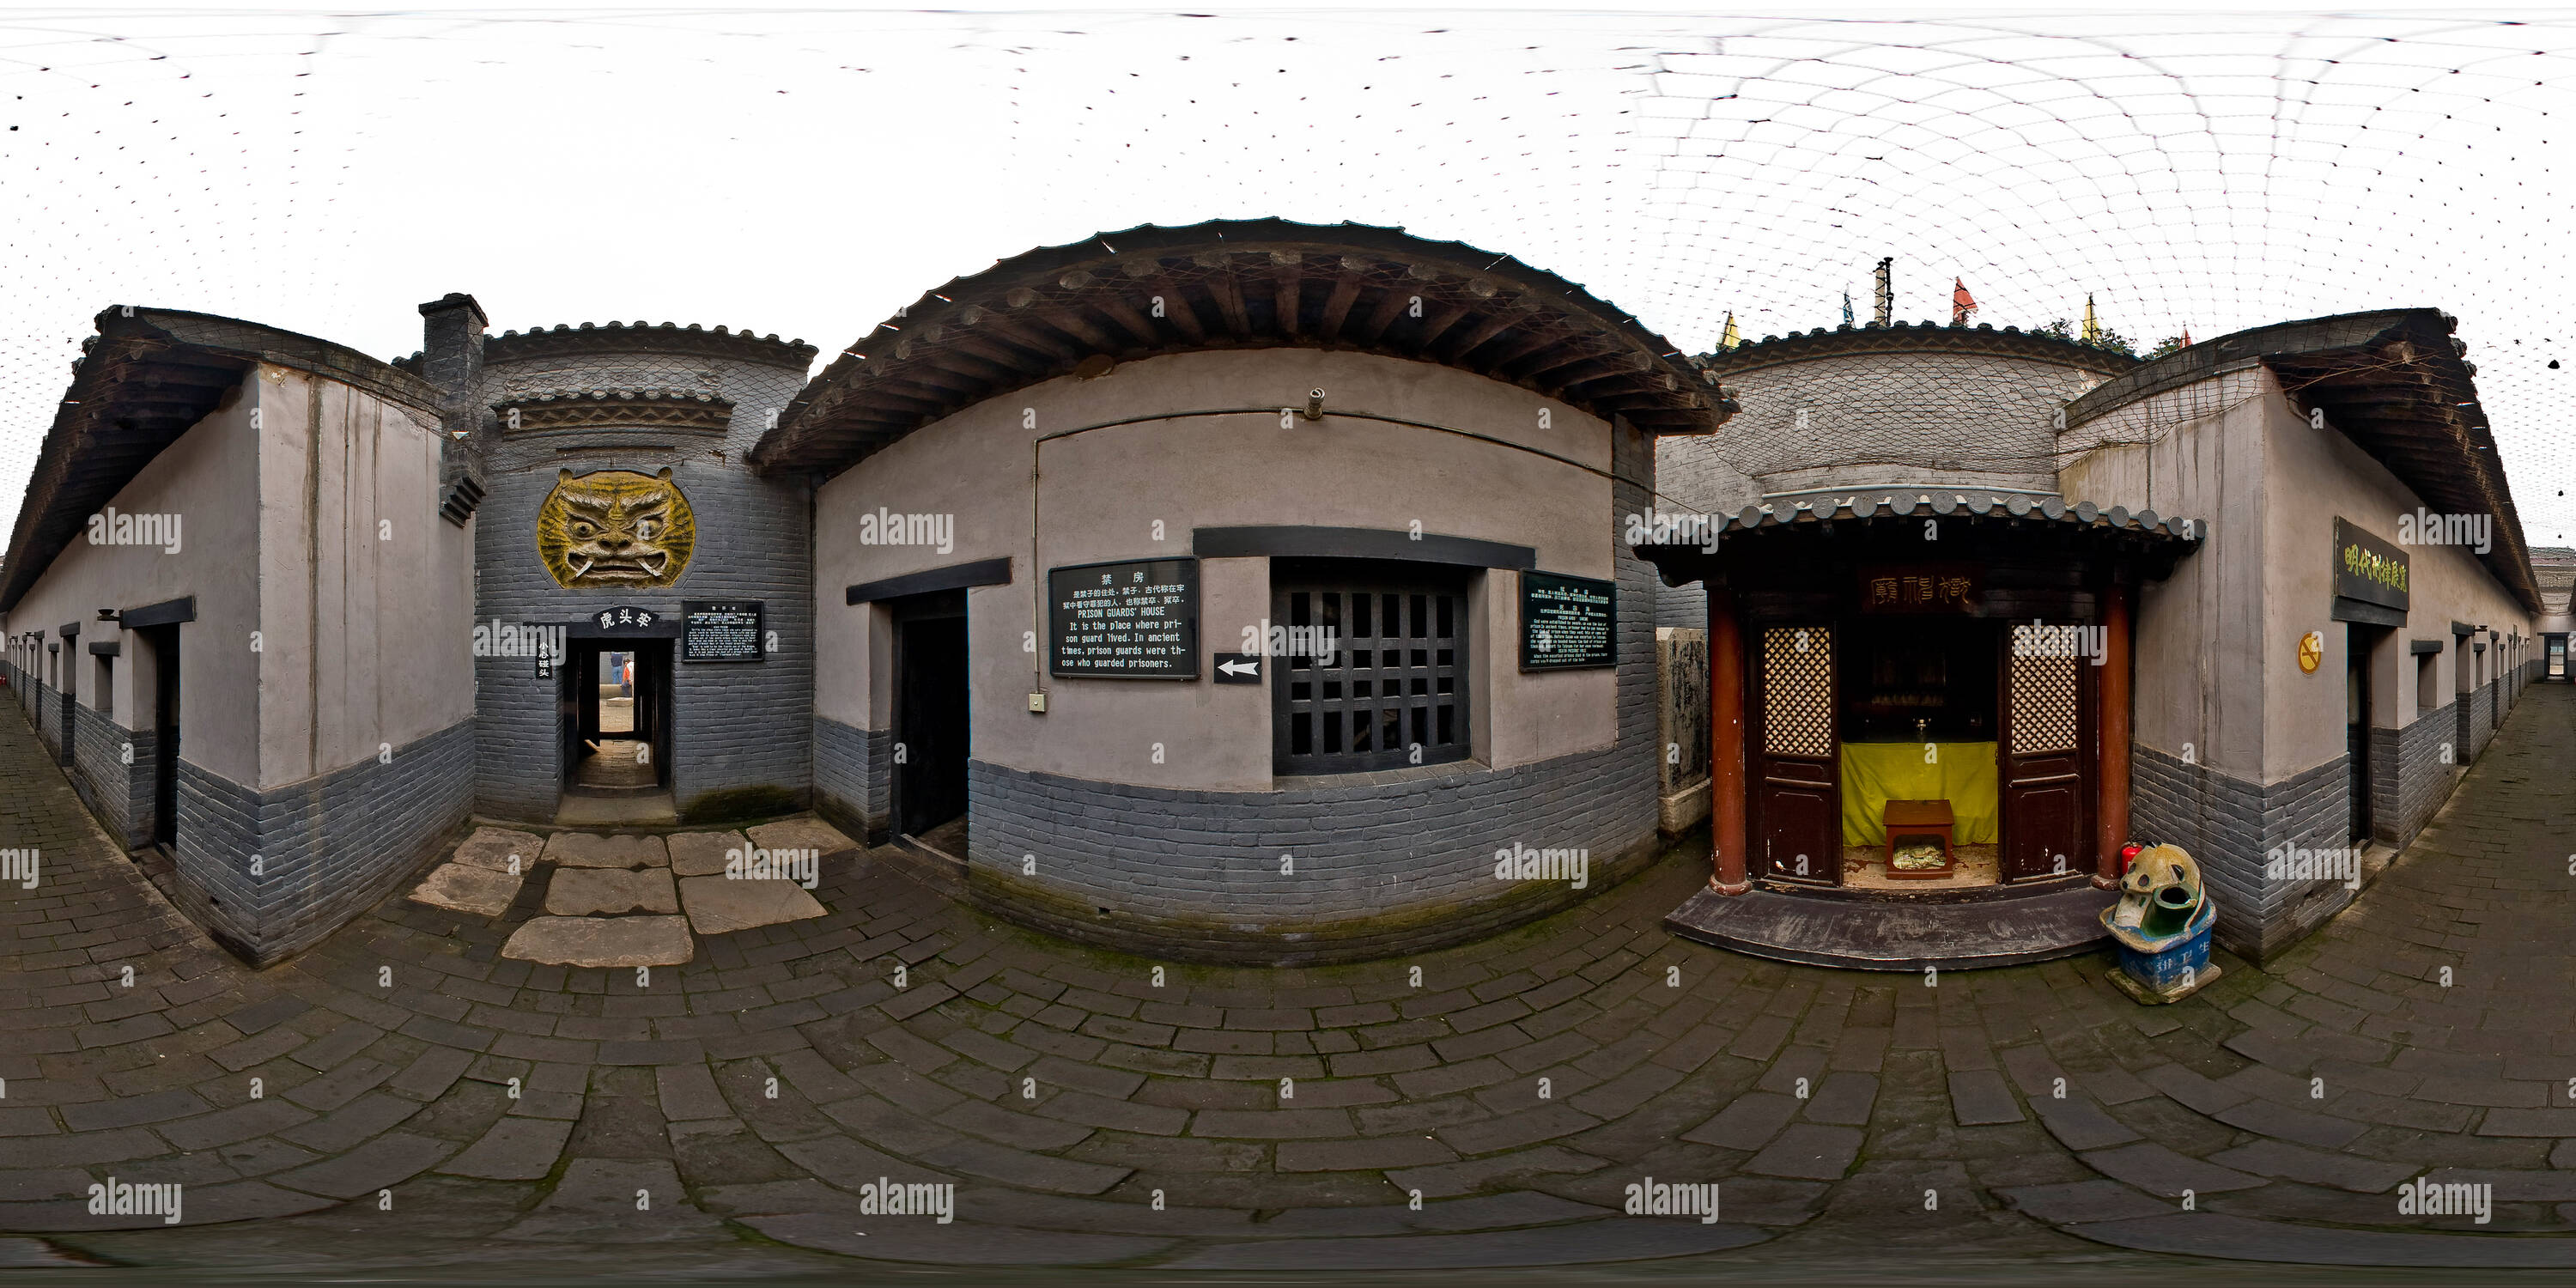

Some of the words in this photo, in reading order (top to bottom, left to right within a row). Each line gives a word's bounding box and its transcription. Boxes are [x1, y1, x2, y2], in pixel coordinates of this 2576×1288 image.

[1078, 609, 1103, 618] PRISON
[1107, 608, 1137, 617] GUARDS'
[1141, 606, 1165, 617] HOUSE
[1070, 623, 1077, 631] It
[1082, 622, 1089, 630] is
[1092, 622, 1106, 630] the
[1109, 621, 1132, 630] place
[1135, 620, 1159, 629] where
[1163, 619, 1182, 629] pri-
[1082, 634, 1103, 644] guard
[1107, 633, 1131, 642] lived.
[1134, 633, 1144, 642] In
[1148, 633, 1181, 642] ancient
[1087, 647, 1112, 655] prison
[1115, 646, 1142, 655] guards
[1170, 646, 1186, 655] th-
[1094, 659, 1125, 668] guarded
[1128, 659, 1172, 668] prisoners.
